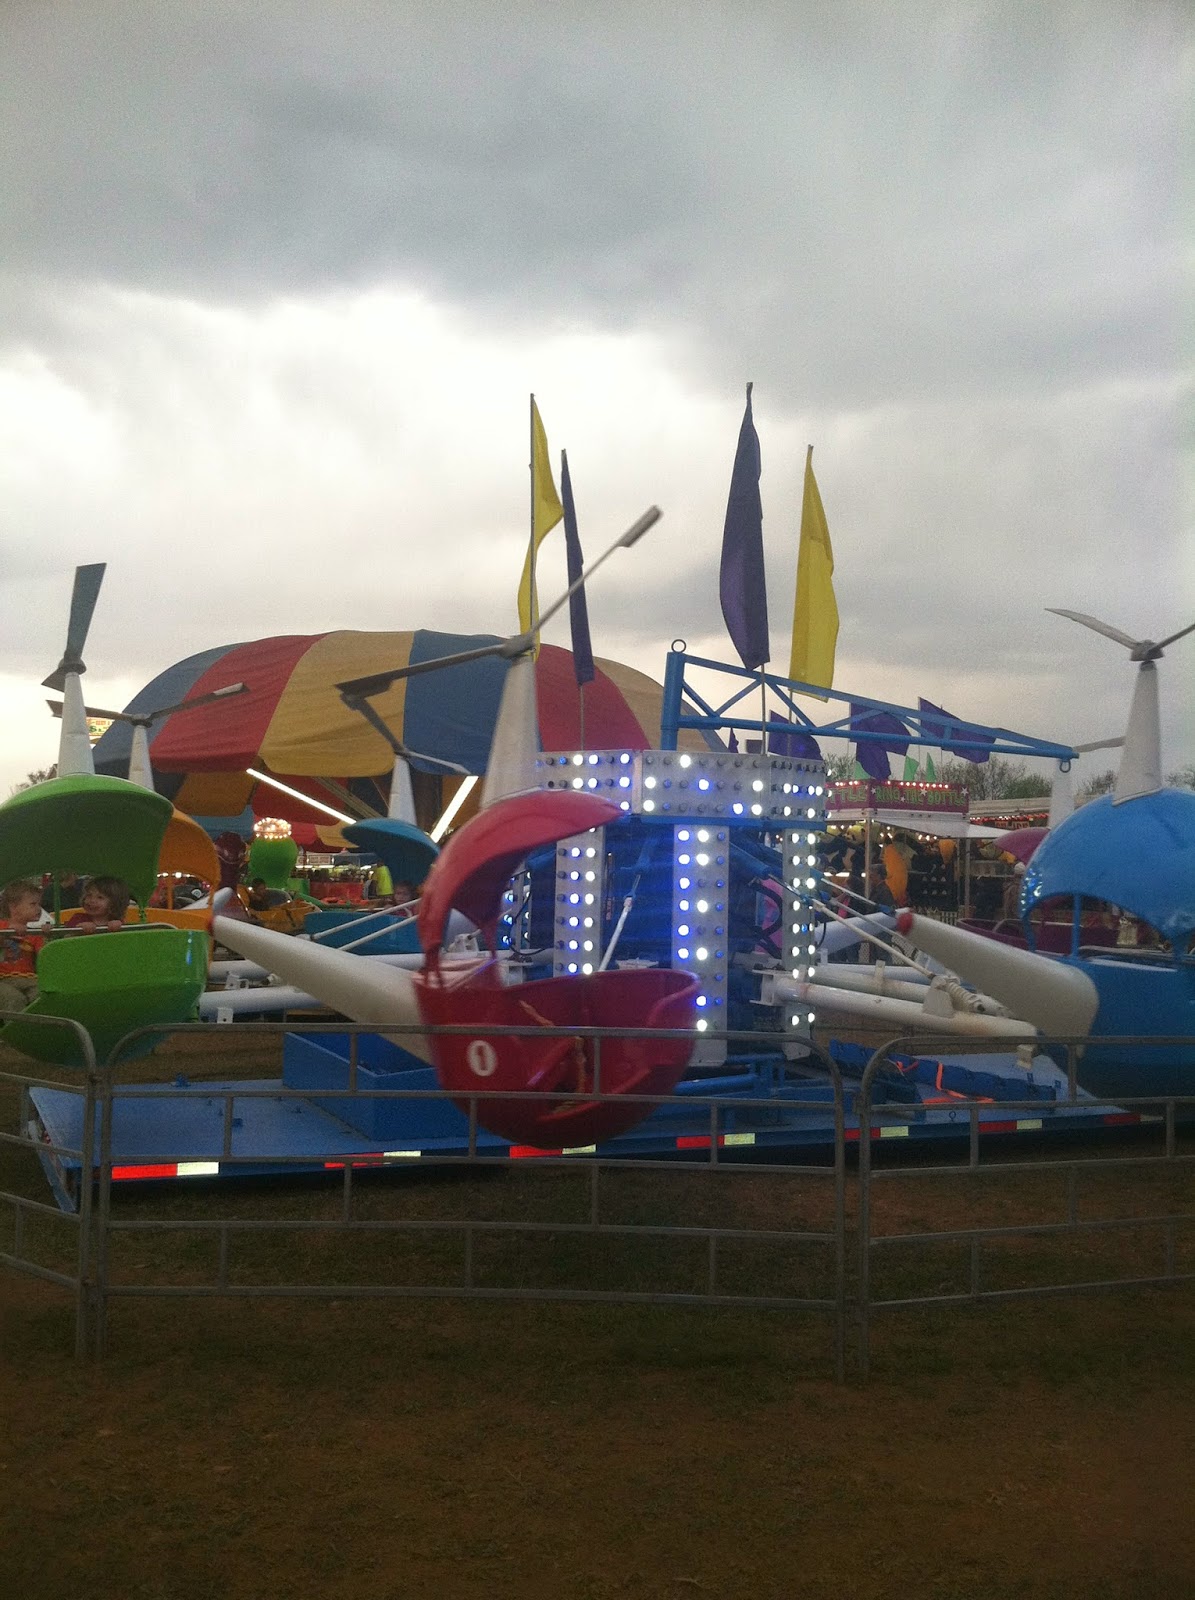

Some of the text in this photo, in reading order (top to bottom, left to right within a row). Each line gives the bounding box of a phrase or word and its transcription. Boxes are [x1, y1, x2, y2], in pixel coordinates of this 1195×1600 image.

[829, 786, 866, 803] TTLE
[876, 786, 965, 806] RING THE BOTTLE
